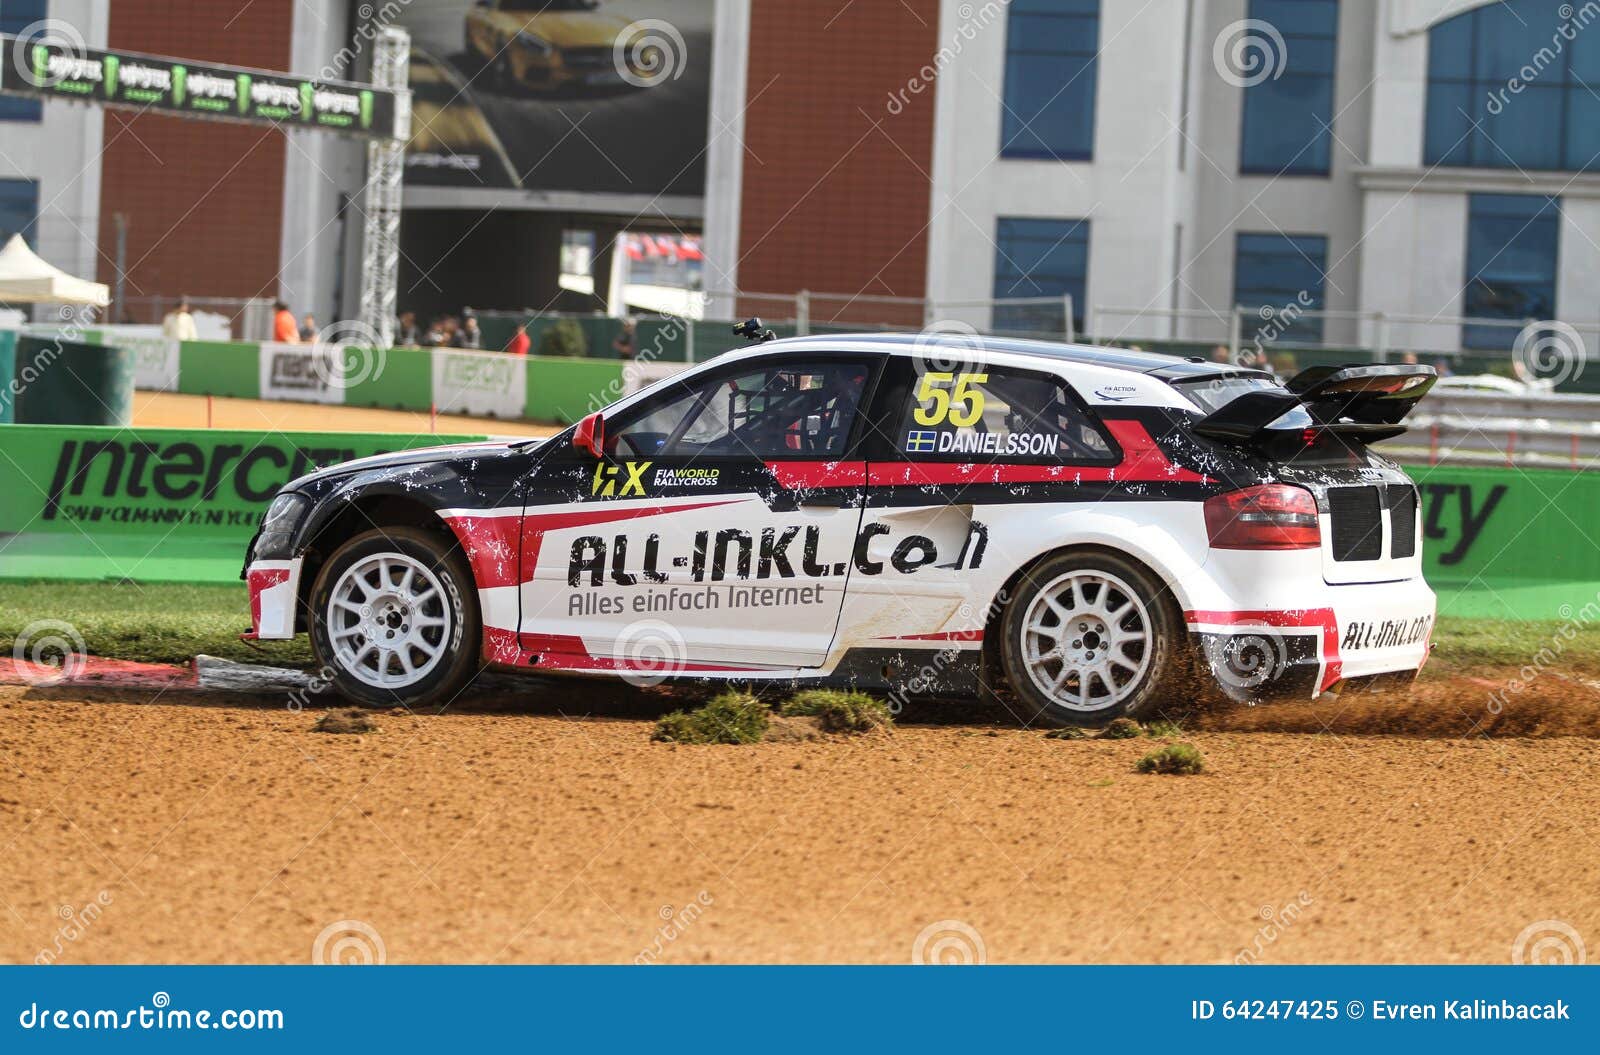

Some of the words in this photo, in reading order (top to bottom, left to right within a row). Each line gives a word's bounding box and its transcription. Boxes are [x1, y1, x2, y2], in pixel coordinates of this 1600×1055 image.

[913, 372, 989, 427] 55
[938, 431, 1059, 455] DANIELSSON
[653, 477, 719, 487] RALLYCROSS
[568, 590, 625, 617] Alles
[632, 586, 724, 613] einfach
[728, 582, 825, 609] Internet
